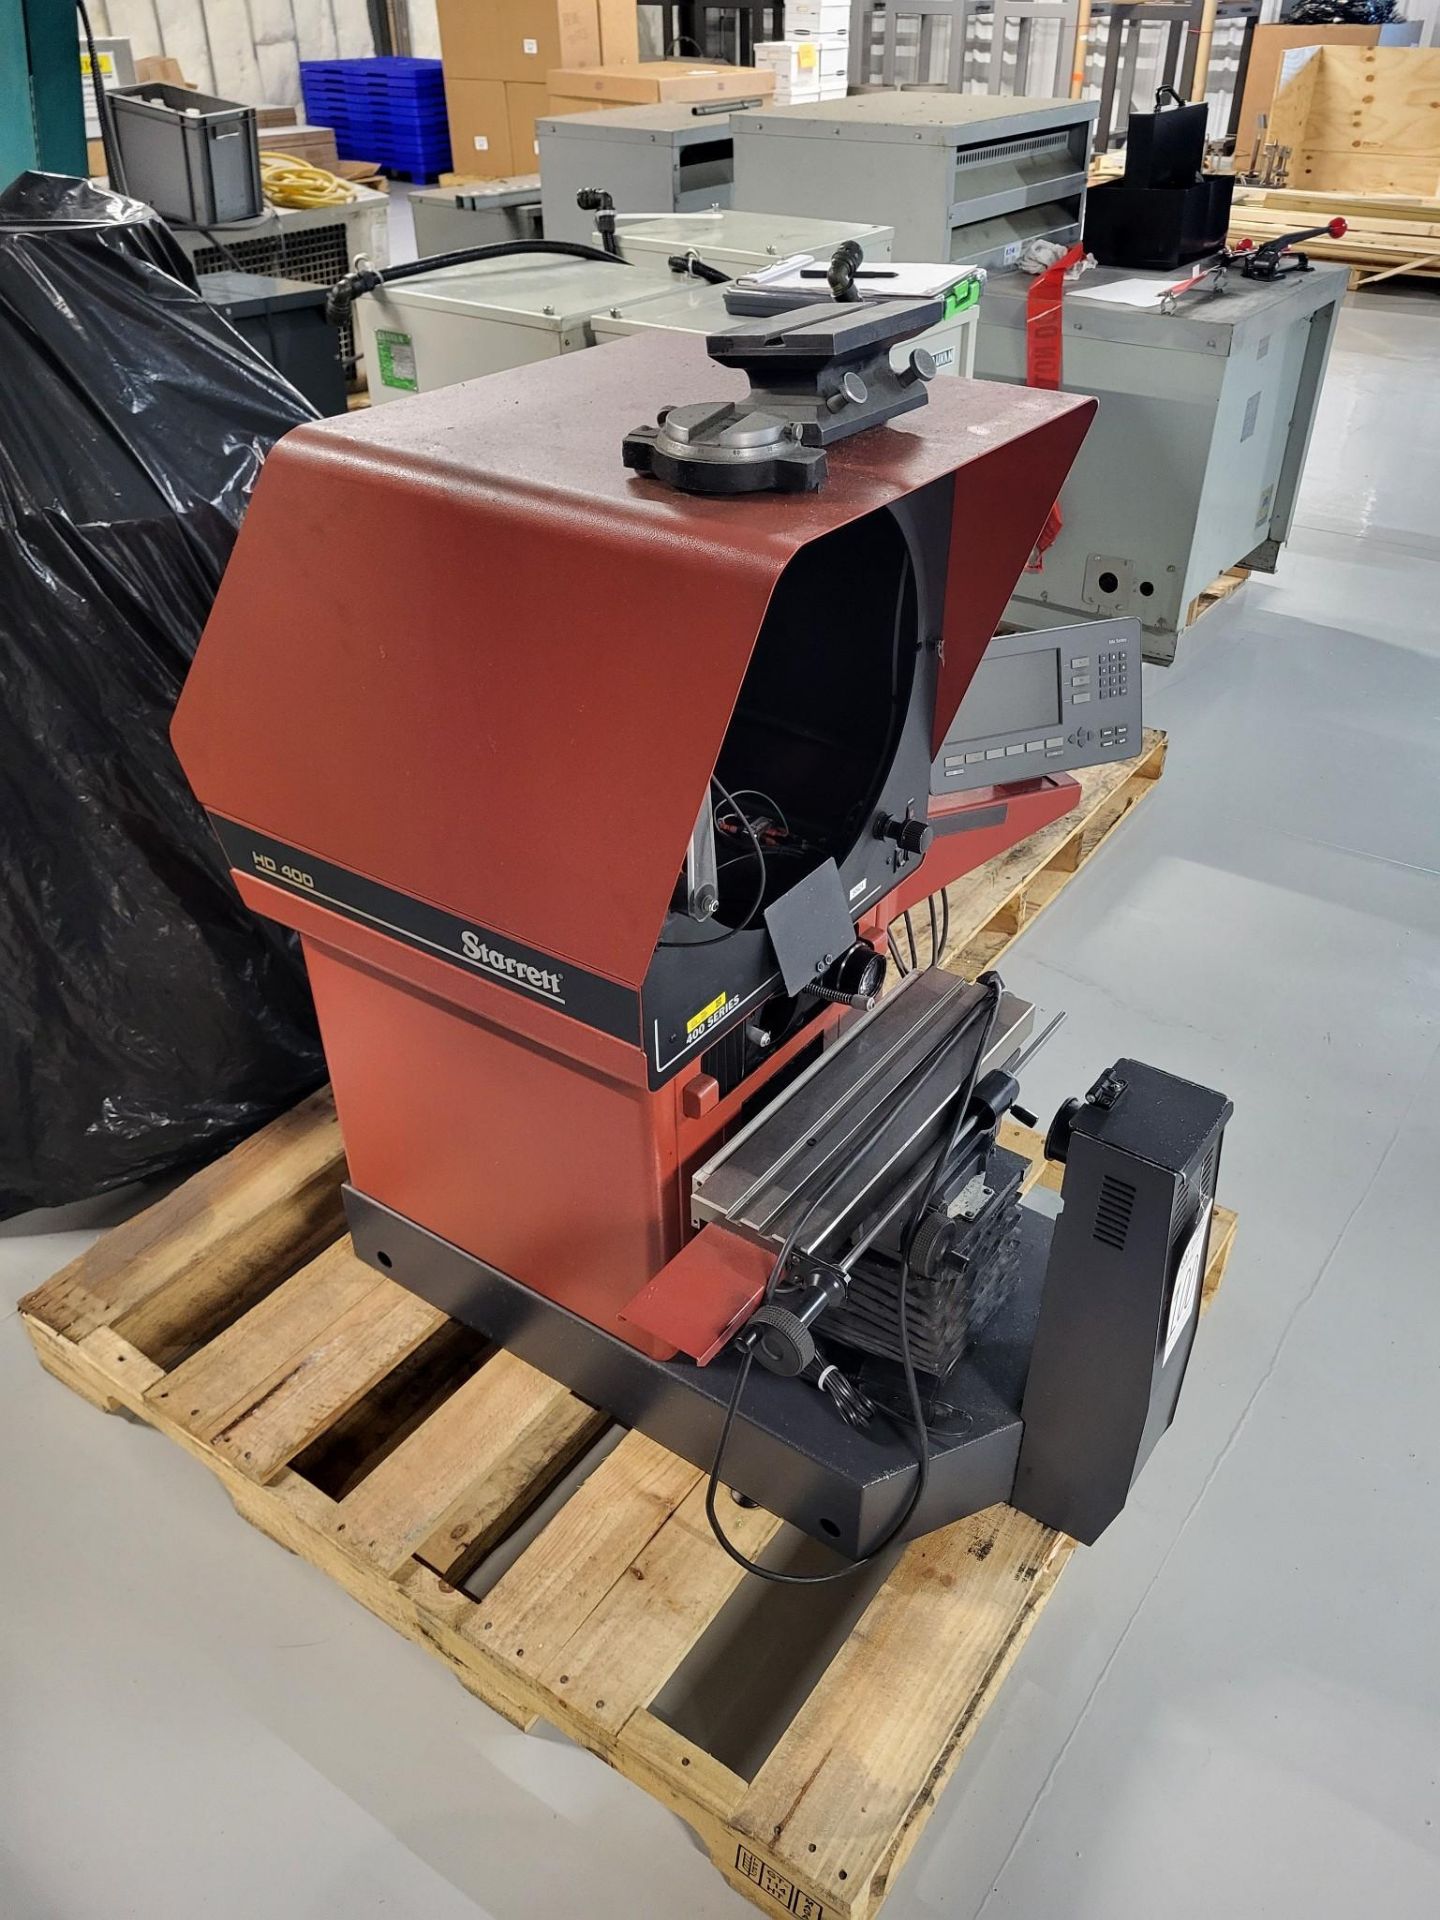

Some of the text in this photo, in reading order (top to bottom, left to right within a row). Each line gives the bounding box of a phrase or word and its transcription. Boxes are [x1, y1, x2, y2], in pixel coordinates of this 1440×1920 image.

[253, 850, 315, 889] HD 400
[460, 930, 562, 993] Starrett
[686, 1023, 705, 1044] 400
[707, 994, 739, 1027] SERIES
[766, 1885, 785, 1900] HT
